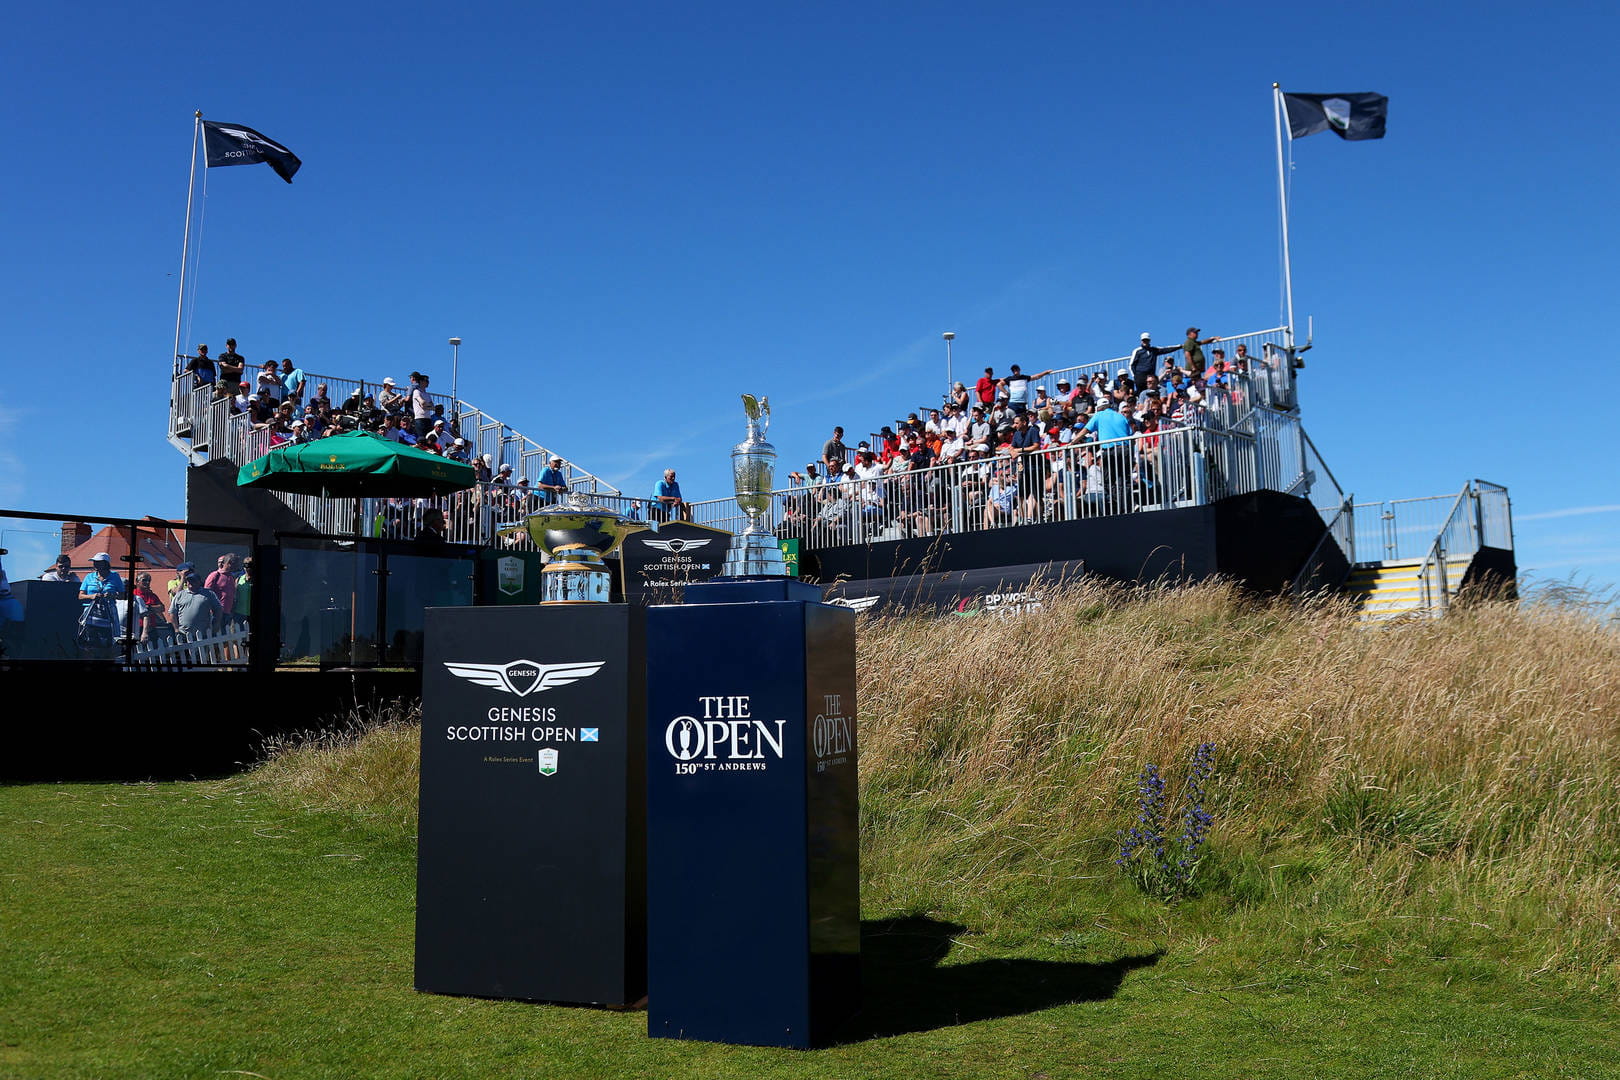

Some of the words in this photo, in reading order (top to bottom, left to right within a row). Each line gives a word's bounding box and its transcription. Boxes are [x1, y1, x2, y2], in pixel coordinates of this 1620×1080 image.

[783, 553, 797, 561] LEX
[488, 707, 557, 722] GENESIS
[699, 696, 751, 719] THE
[824, 694, 842, 716] THE
[447, 726, 526, 741] SCOTTISH
[531, 727, 576, 742] OPEN
[665, 715, 787, 761] OPEN
[813, 714, 853, 758] OPEN
[704, 762, 716, 771] ST
[718, 762, 766, 771] ANDREWS
